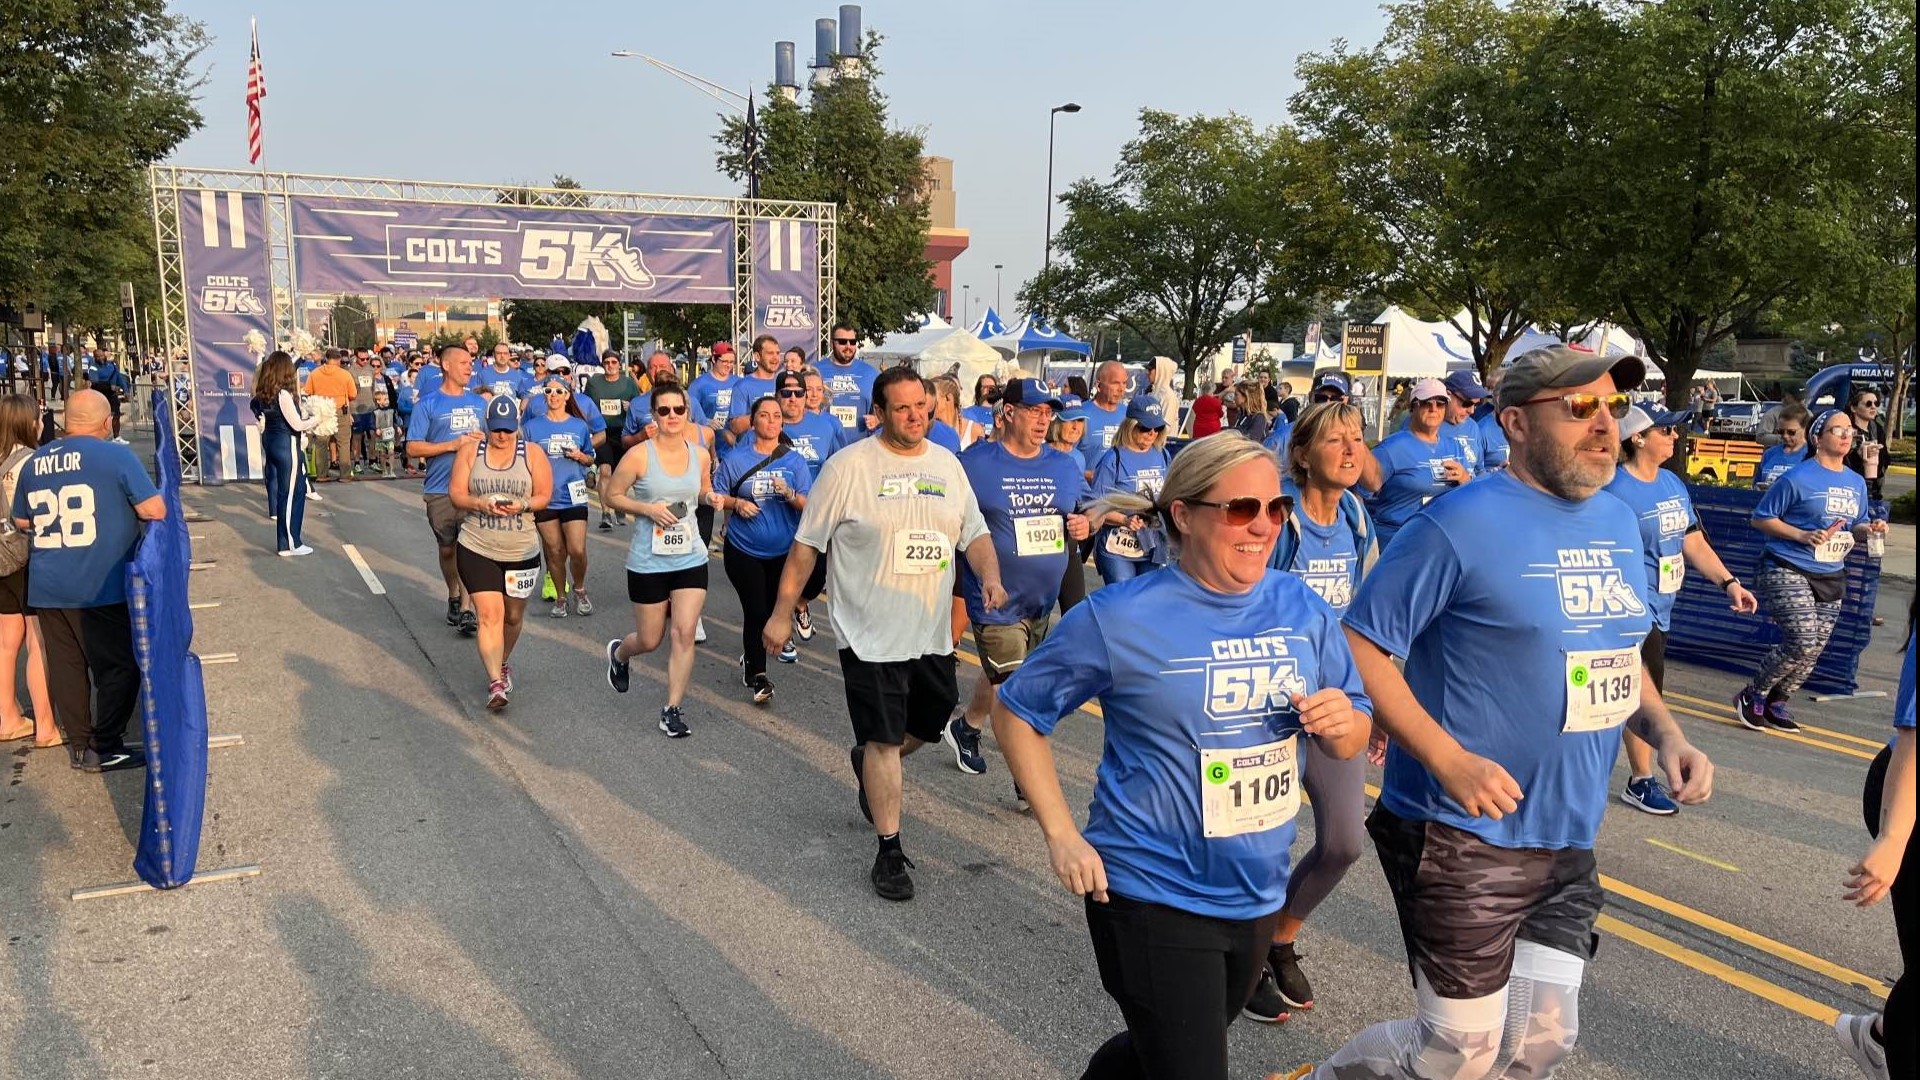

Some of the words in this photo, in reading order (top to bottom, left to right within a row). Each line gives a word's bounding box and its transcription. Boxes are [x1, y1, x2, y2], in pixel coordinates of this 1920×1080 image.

[406, 237, 501, 264] COLTS
[519, 228, 622, 282] 5K
[207, 275, 249, 286] COLTS
[203, 290, 250, 312] 5K
[771, 295, 802, 304] COLTS
[766, 307, 803, 326] 5K
[1348, 325, 1363, 333] EXIT
[1365, 325, 1382, 333] ONLY
[1347, 337, 1377, 345] PARKING
[1347, 346, 1363, 354] LOTS
[1364, 346, 1370, 354] A
[1377, 346, 1383, 354] B
[34, 451, 81, 476] TAYLOR
[473, 478, 527, 498] INDIANAPOLIS
[883, 478, 919, 496] 5K
[28, 483, 97, 548] 28
[479, 511, 523, 531] COLTS
[663, 534, 684, 545] 865
[1026, 529, 1057, 543] 1920
[1115, 536, 1139, 549] 1468
[905, 545, 942, 560] 2323
[1826, 542, 1849, 553] 1079
[1557, 548, 1613, 568] COLTS
[1308, 559, 1347, 573] COLTS
[517, 578, 535, 590] 888
[1561, 574, 1624, 614] 5K
[1211, 636, 1289, 660] COLTS
[1575, 670, 1583, 682] G
[1210, 665, 1293, 713] 5K
[1587, 674, 1631, 705] 1139
[1237, 756, 1261, 767] COLTS
[1212, 767, 1224, 779] G
[1229, 769, 1290, 808] 1105
